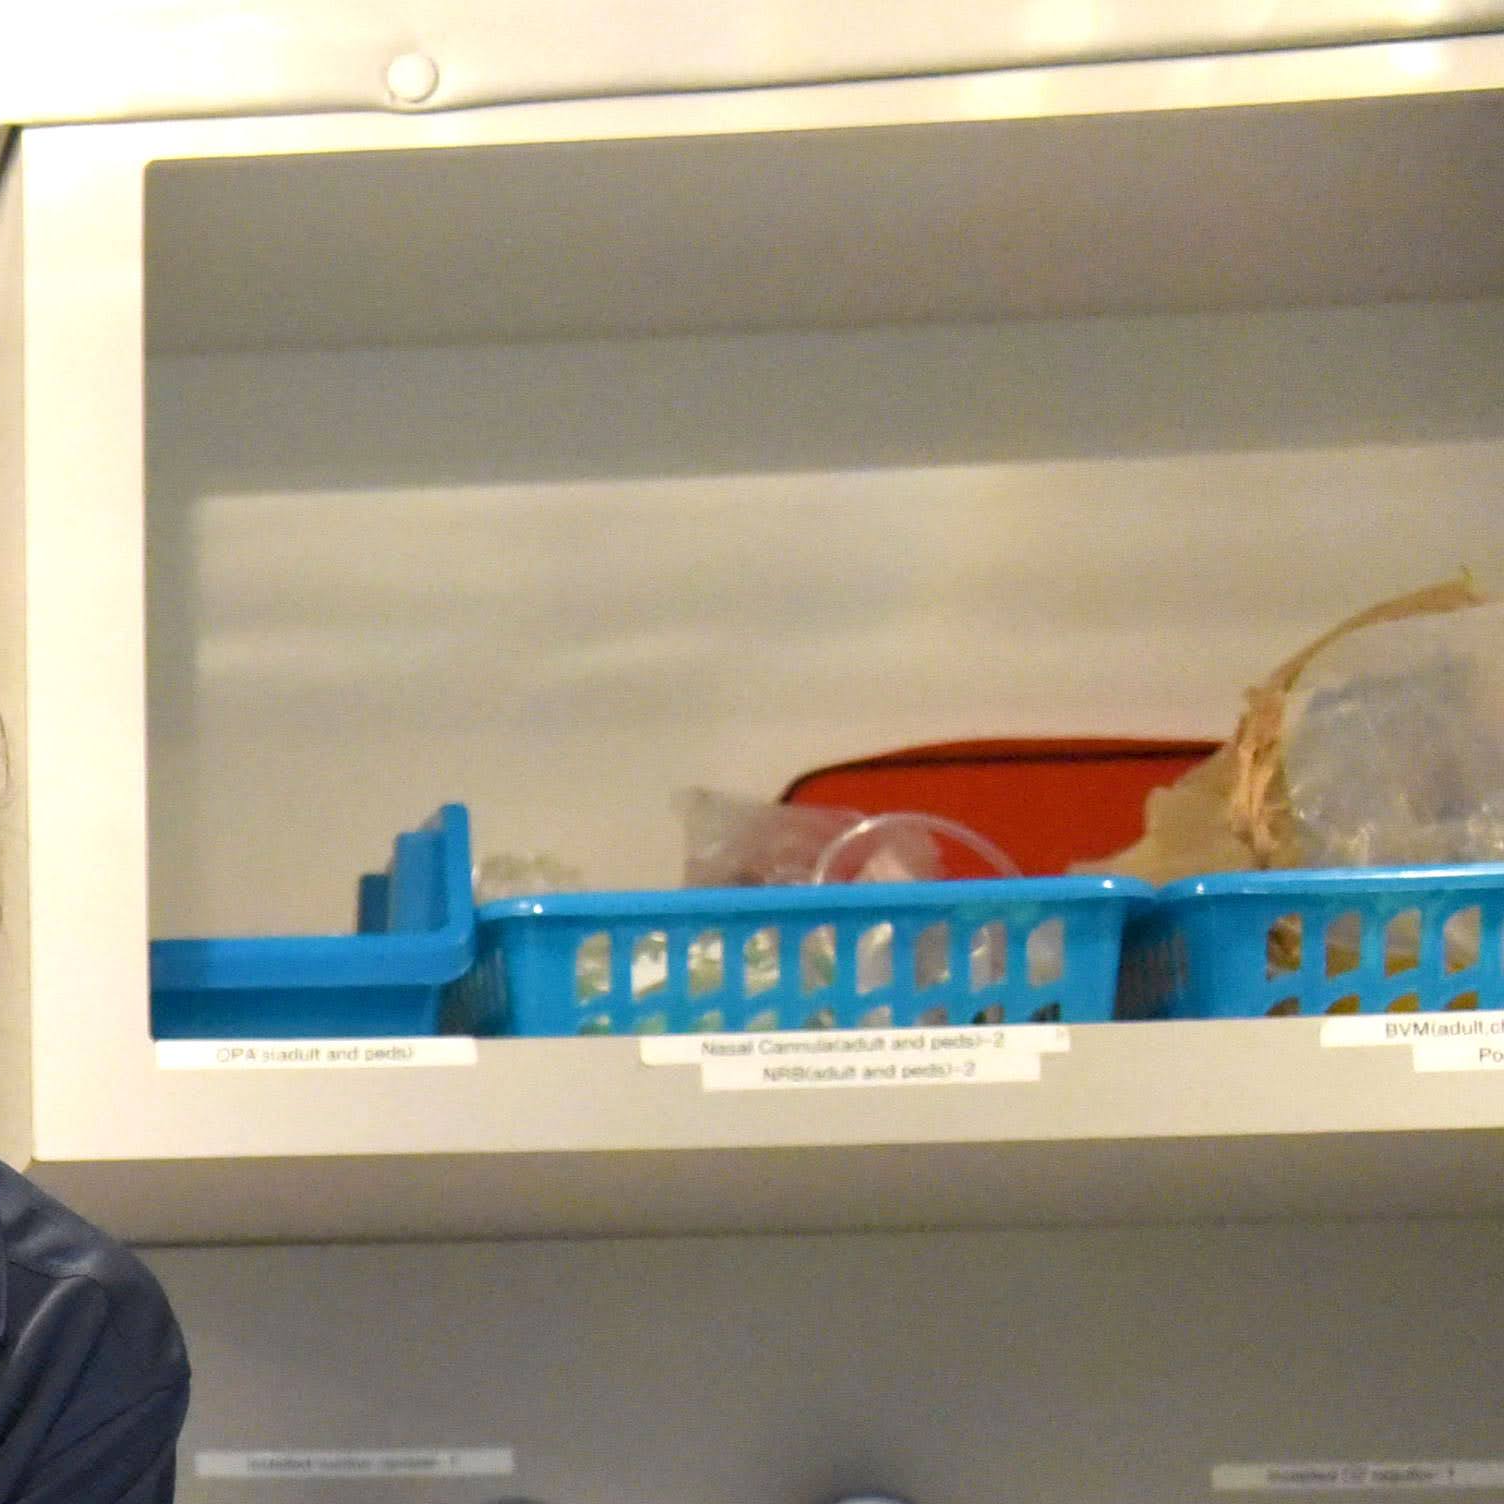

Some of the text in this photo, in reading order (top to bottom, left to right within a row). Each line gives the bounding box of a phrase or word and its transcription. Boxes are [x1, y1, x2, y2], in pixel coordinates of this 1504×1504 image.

[891, 1033, 924, 1049] and
[327, 1046, 358, 1062] and
[864, 1063, 896, 1079] and
